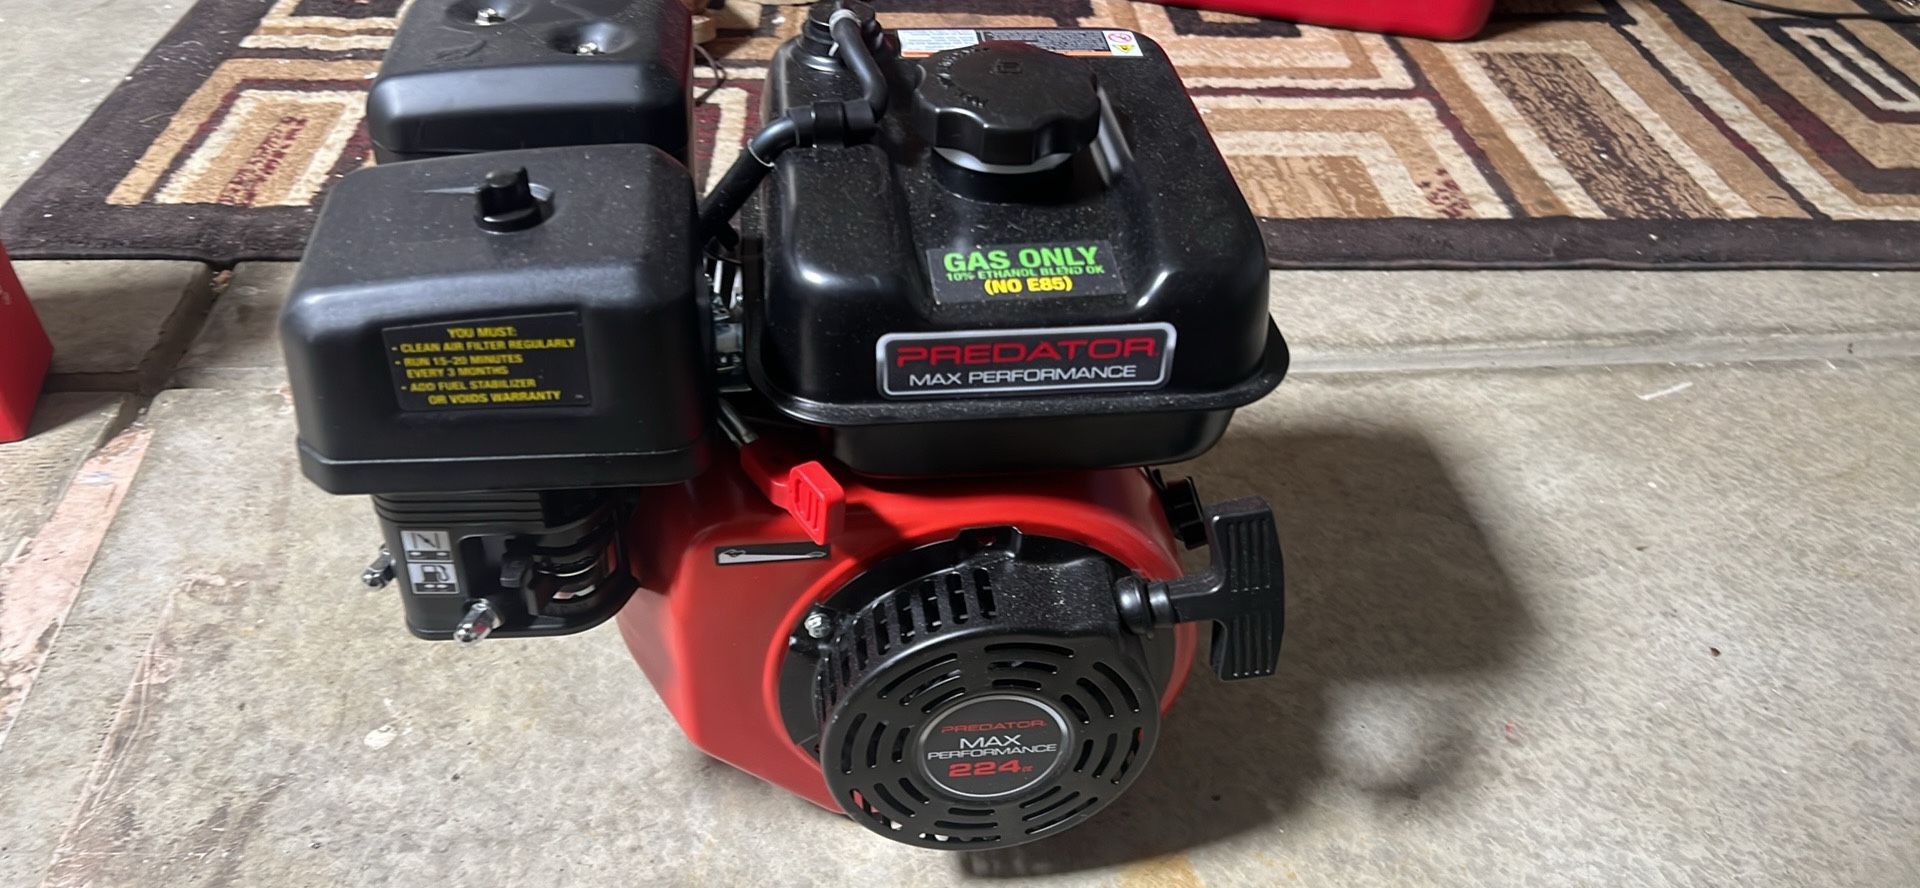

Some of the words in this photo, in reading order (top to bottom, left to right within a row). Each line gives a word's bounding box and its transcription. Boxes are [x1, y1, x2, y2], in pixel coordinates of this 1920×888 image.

[944, 251, 1010, 271] GAS
[1019, 247, 1097, 267] ONLY
[978, 267, 1038, 280] ETHANOL
[1040, 265, 1084, 277] BLEND
[984, 277, 1023, 295] (NO
[1027, 275, 1073, 292] E85)
[447, 327, 475, 338] YOU
[477, 326, 517, 337] MUST:
[400, 342, 441, 353] CLEAN
[443, 341, 464, 351] AIR
[466, 340, 506, 350] FILTER
[508, 338, 576, 349] REGULARLY
[896, 337, 1157, 367] PREDATOR
[403, 357, 430, 367] RUN
[469, 354, 524, 364] MINUTES
[406, 368, 444, 378] EVERY
[447, 368, 456, 377] 3
[458, 366, 509, 376] MONTHS
[909, 373, 962, 387] MAX
[968, 365, 1137, 384] PERFORMANCE
[410, 382, 436, 392] ADD
[438, 381, 467, 390] FUEL
[469, 378, 537, 389] STABILIZER
[428, 395, 448, 405] OR
[450, 393, 489, 404] VOIDS
[491, 390, 561, 402] WARRANTY
[942, 720, 1045, 733] PREDATOR
[960, 735, 1021, 749] MAX
[928, 744, 1057, 760] PERFORMANCE
